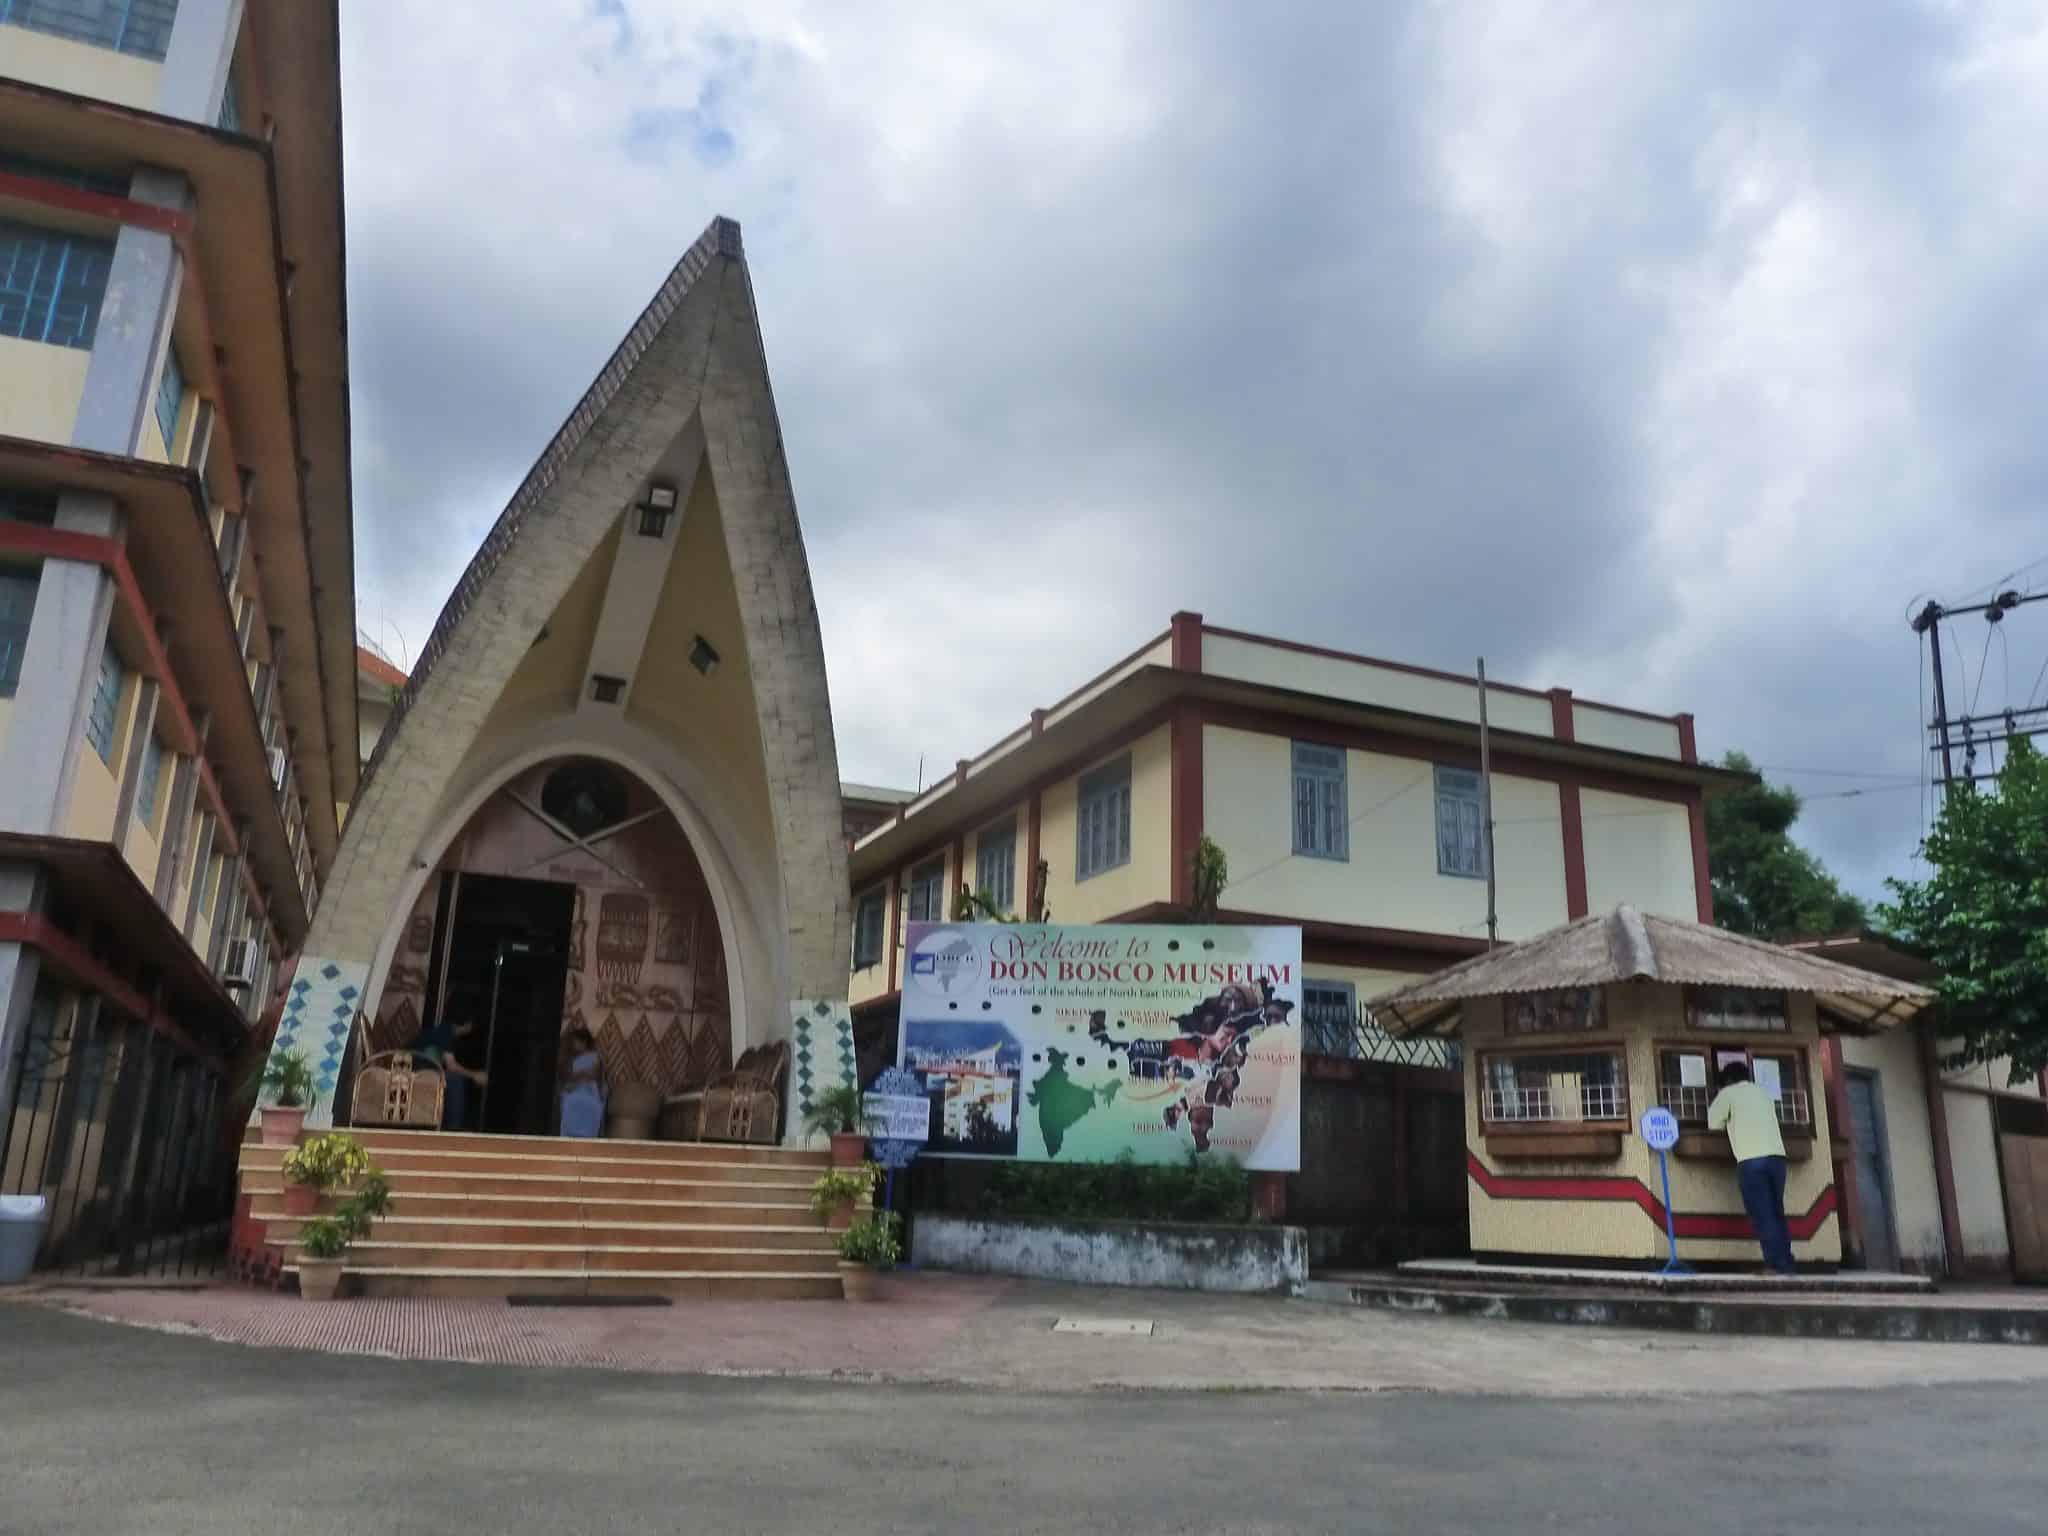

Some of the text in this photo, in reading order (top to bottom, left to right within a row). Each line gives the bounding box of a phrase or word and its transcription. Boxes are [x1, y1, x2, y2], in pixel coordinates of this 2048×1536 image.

[989, 930, 1150, 961] Welcome to
[990, 960, 1291, 985] DON BOSCO MUSEUM
[1037, 984, 1048, 996] of
[1049, 985, 1065, 997] the
[1067, 985, 1095, 998] whole
[1096, 986, 1107, 998] of
[1109, 987, 1137, 999] North
